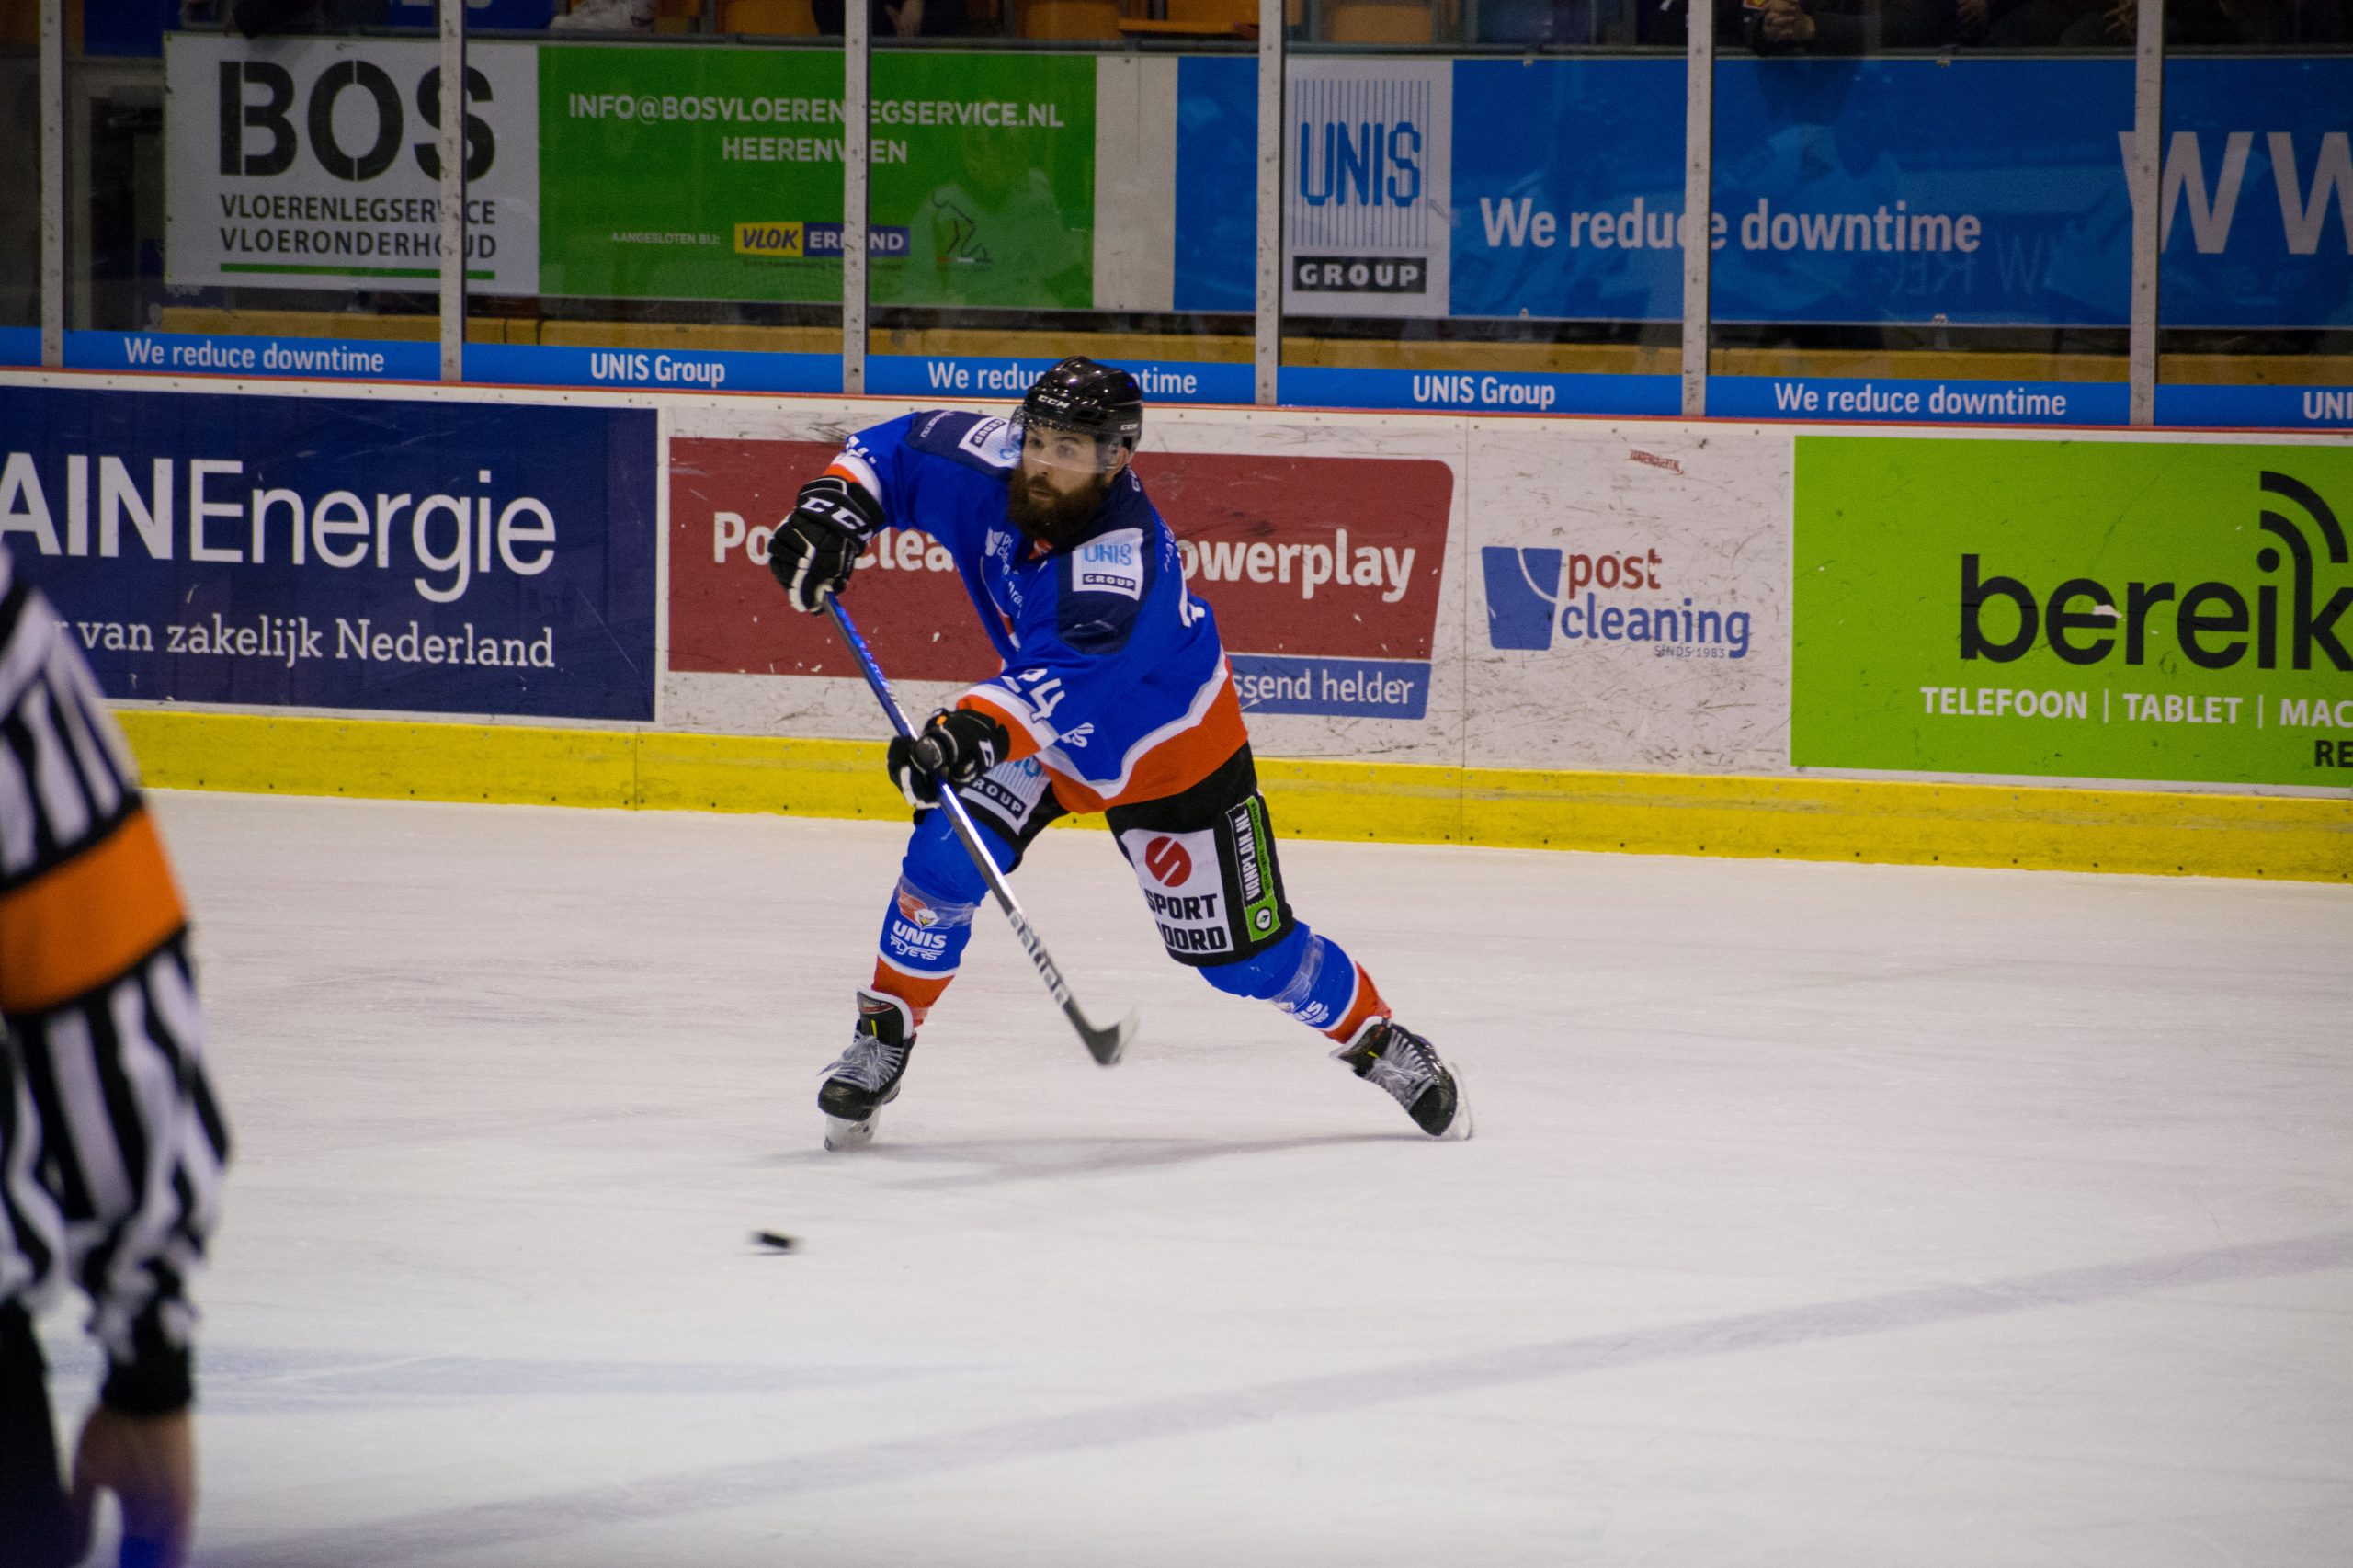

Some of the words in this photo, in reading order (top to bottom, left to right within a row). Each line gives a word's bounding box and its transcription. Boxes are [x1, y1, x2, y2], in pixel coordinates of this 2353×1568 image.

[219, 60, 496, 183] BOS
[569, 94, 1064, 128] INFO@BOSVLOERENEGSERVICE.NL
[722, 136, 907, 164] HEERENVEN
[1300, 121, 1422, 208] UNIS
[221, 194, 496, 225] VLOERENLEGSERCE
[1480, 197, 1557, 248] We
[1741, 198, 1982, 253] downtime
[221, 227, 497, 259] VLOERONDERHUD
[611, 232, 696, 244] AANGESLOTEN
[742, 228, 798, 250] VLOK
[809, 231, 904, 251] ERND
[1299, 264, 1420, 287] GROUP
[124, 337, 165, 366] We
[172, 341, 258, 369] reduce
[264, 343, 385, 372] downtime
[590, 353, 649, 381] UNIS
[654, 355, 726, 388] Group
[928, 362, 969, 389] We
[977, 363, 1045, 390] redu
[1413, 375, 1475, 403] UNIS
[1480, 376, 1555, 410] Group
[1037, 394, 1071, 409] CCM
[1774, 383, 1819, 411] We
[1826, 384, 1920, 414] reduce
[1928, 386, 2067, 415] downtime
[2303, 392, 2353, 420] UNI
[973, 419, 1004, 446] GROUP
[0, 452, 556, 603] AINEnergie
[713, 511, 772, 566] Po
[1176, 528, 1416, 603] owerplay
[1084, 543, 1132, 566] UNIS
[1084, 574, 1135, 588] GROUP
[1568, 548, 1663, 599] post
[1561, 592, 1751, 659] cleaning
[1961, 549, 2353, 671] bereik
[77, 620, 154, 652] van
[167, 612, 324, 668] zakelijk
[335, 618, 555, 667] Nederland
[1654, 645, 1693, 659] SINDS
[1697, 647, 1725, 659] 1983
[1233, 668, 1312, 701] ssend
[1322, 668, 1415, 704] helder
[1920, 687, 2087, 720] TELEFOON
[2123, 693, 2243, 724] TABLET
[2279, 698, 2353, 728] MAC
[972, 778, 1023, 813] ROUP
[1234, 809, 1261, 901] VANPLAN.NL
[1144, 888, 1218, 920] SPORT
[892, 919, 948, 949] UNIS
[1157, 920, 1228, 951] OORD
